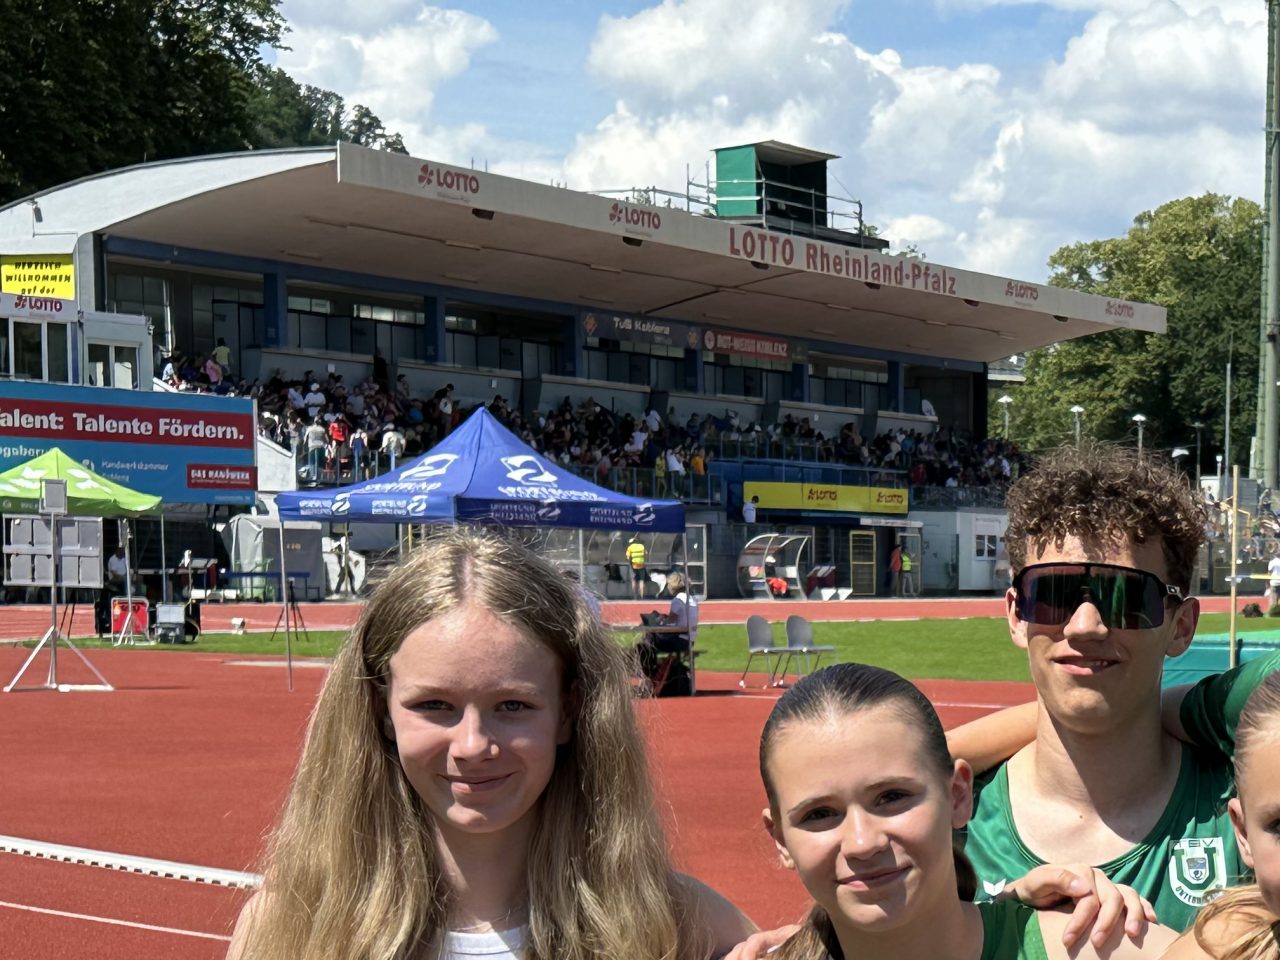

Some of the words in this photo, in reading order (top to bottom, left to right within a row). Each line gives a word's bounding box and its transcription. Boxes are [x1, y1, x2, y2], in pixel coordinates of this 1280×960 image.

[437, 168, 480, 194] LOTTO
[625, 207, 661, 230] LOTTO
[729, 227, 794, 265] LOTTO
[806, 243, 956, 295] Rheinland-Pfalz
[28, 297, 63, 312] LOTTO
[0, 408, 64, 430] alent:
[73, 412, 153, 435] Talente
[158, 418, 244, 440] Fördern.
